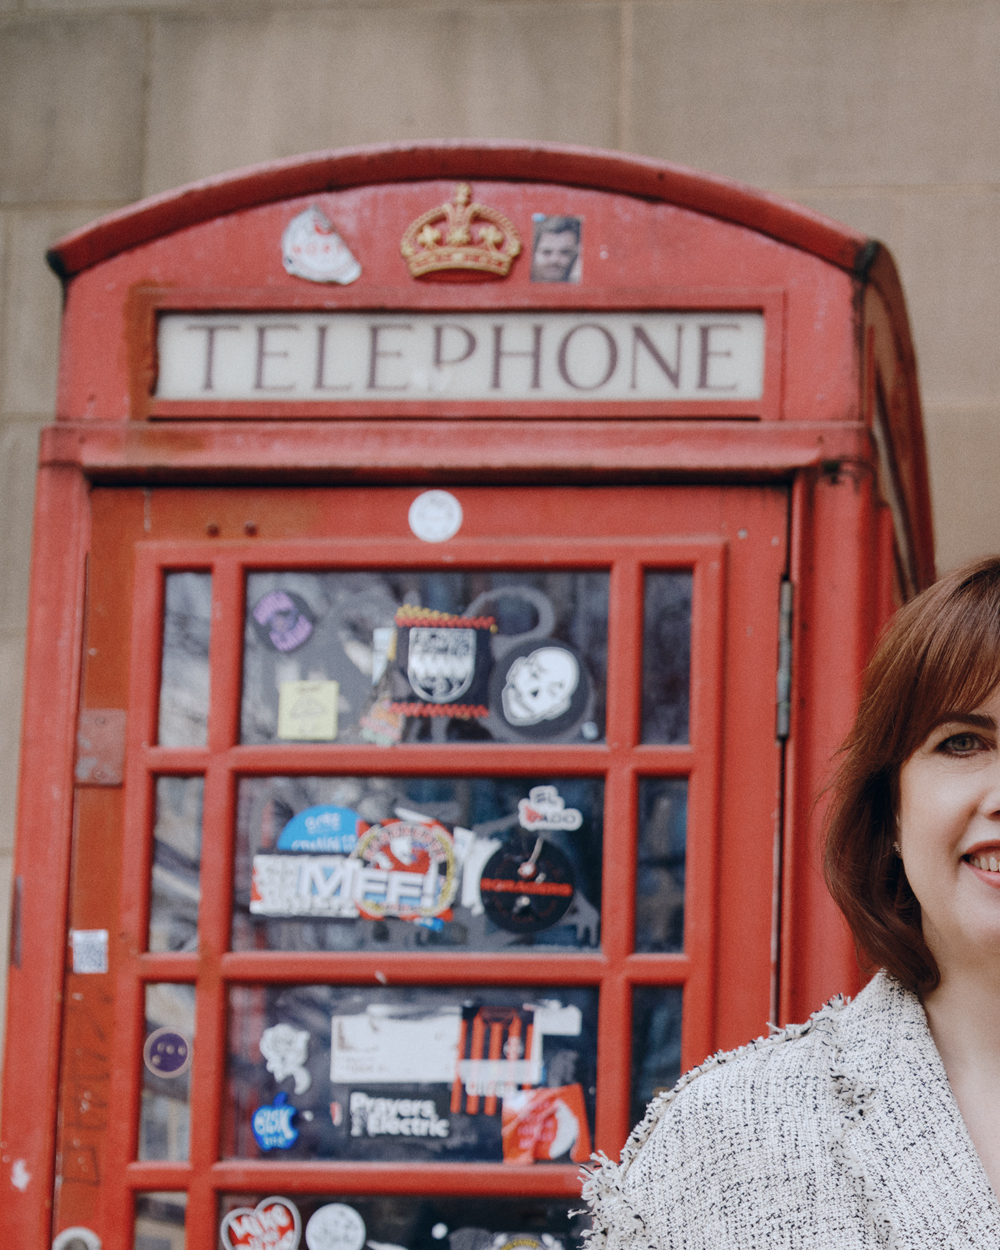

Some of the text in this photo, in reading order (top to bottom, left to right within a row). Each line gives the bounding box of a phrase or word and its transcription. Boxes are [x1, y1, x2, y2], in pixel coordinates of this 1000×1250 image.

[186, 322, 742, 392] TELEPHONE
[351, 1092, 437, 1121] Prayers
[367, 1111, 450, 1138] Electric
